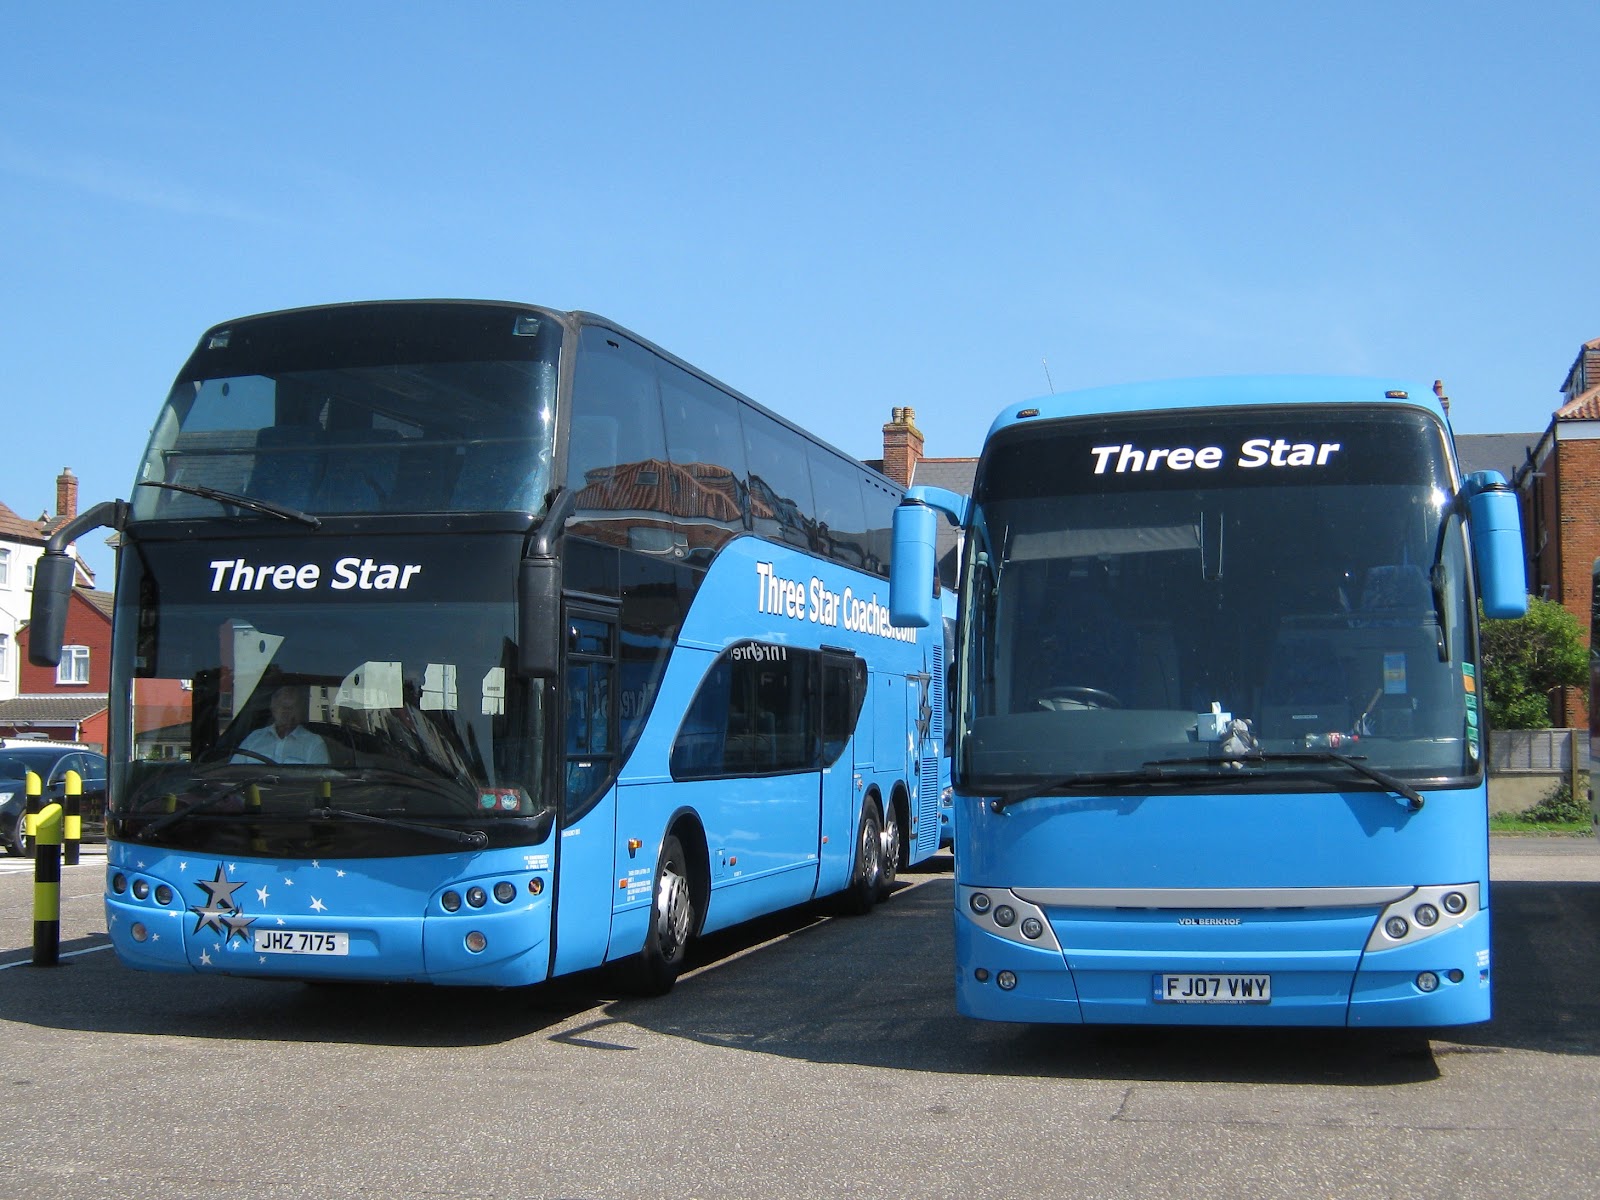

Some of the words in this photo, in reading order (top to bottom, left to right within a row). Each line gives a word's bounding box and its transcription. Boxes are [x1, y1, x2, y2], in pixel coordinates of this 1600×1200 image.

[1090, 443, 1223, 474] Three
[1238, 438, 1341, 468] Star
[209, 558, 321, 591] Three
[330, 557, 422, 590] Star
[756, 560, 806, 621] Three
[808, 575, 840, 628] Star
[261, 932, 294, 950] JHZ
[299, 934, 336, 951] 7175
[1167, 978, 1220, 997] FJ07
[1227, 978, 1267, 997] VWY
